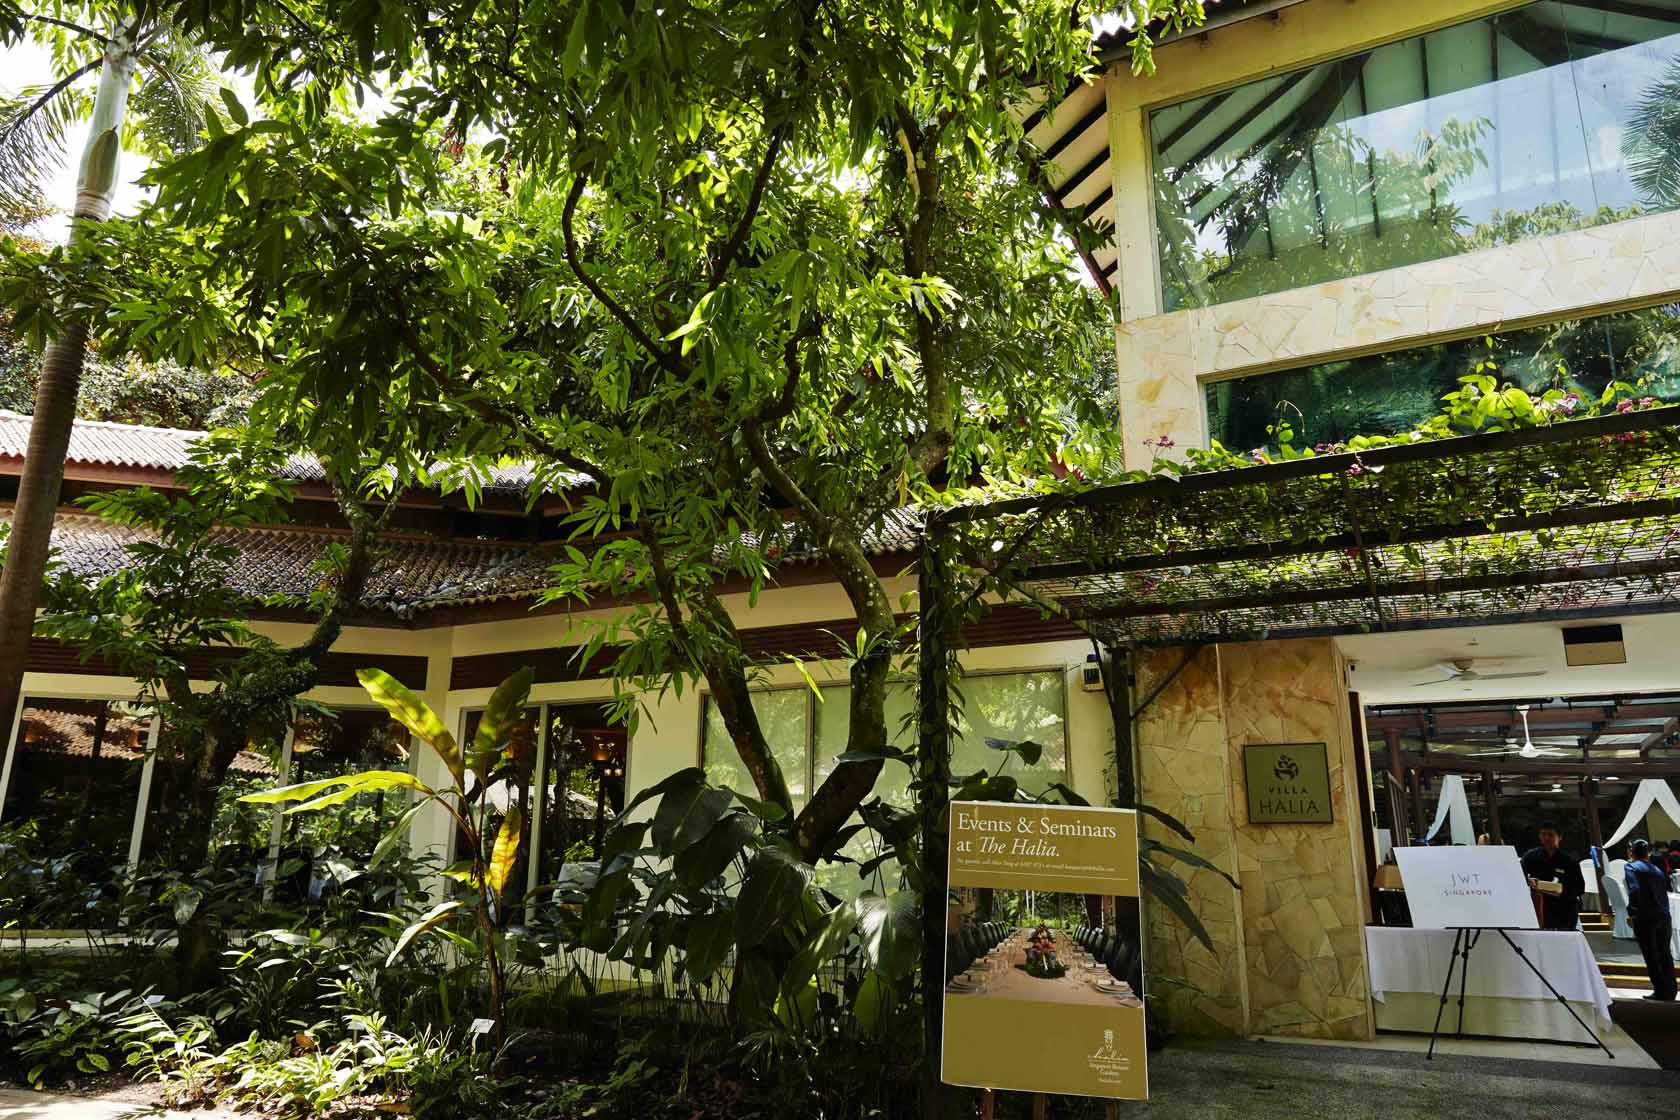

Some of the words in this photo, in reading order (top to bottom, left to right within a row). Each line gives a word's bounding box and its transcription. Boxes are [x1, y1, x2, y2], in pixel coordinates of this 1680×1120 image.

[1268, 785, 1309, 794] VILLA
[1259, 799, 1321, 816] HALIA
[958, 813, 1012, 832] Events
[1016, 817, 1036, 834] &
[1040, 817, 1118, 839] Seminars
[956, 840, 972, 853] at
[979, 836, 1007, 854] The
[1010, 838, 1061, 857] Halia.
[1450, 872, 1481, 887] JWT
[1443, 888, 1493, 897] SINGAPORE
